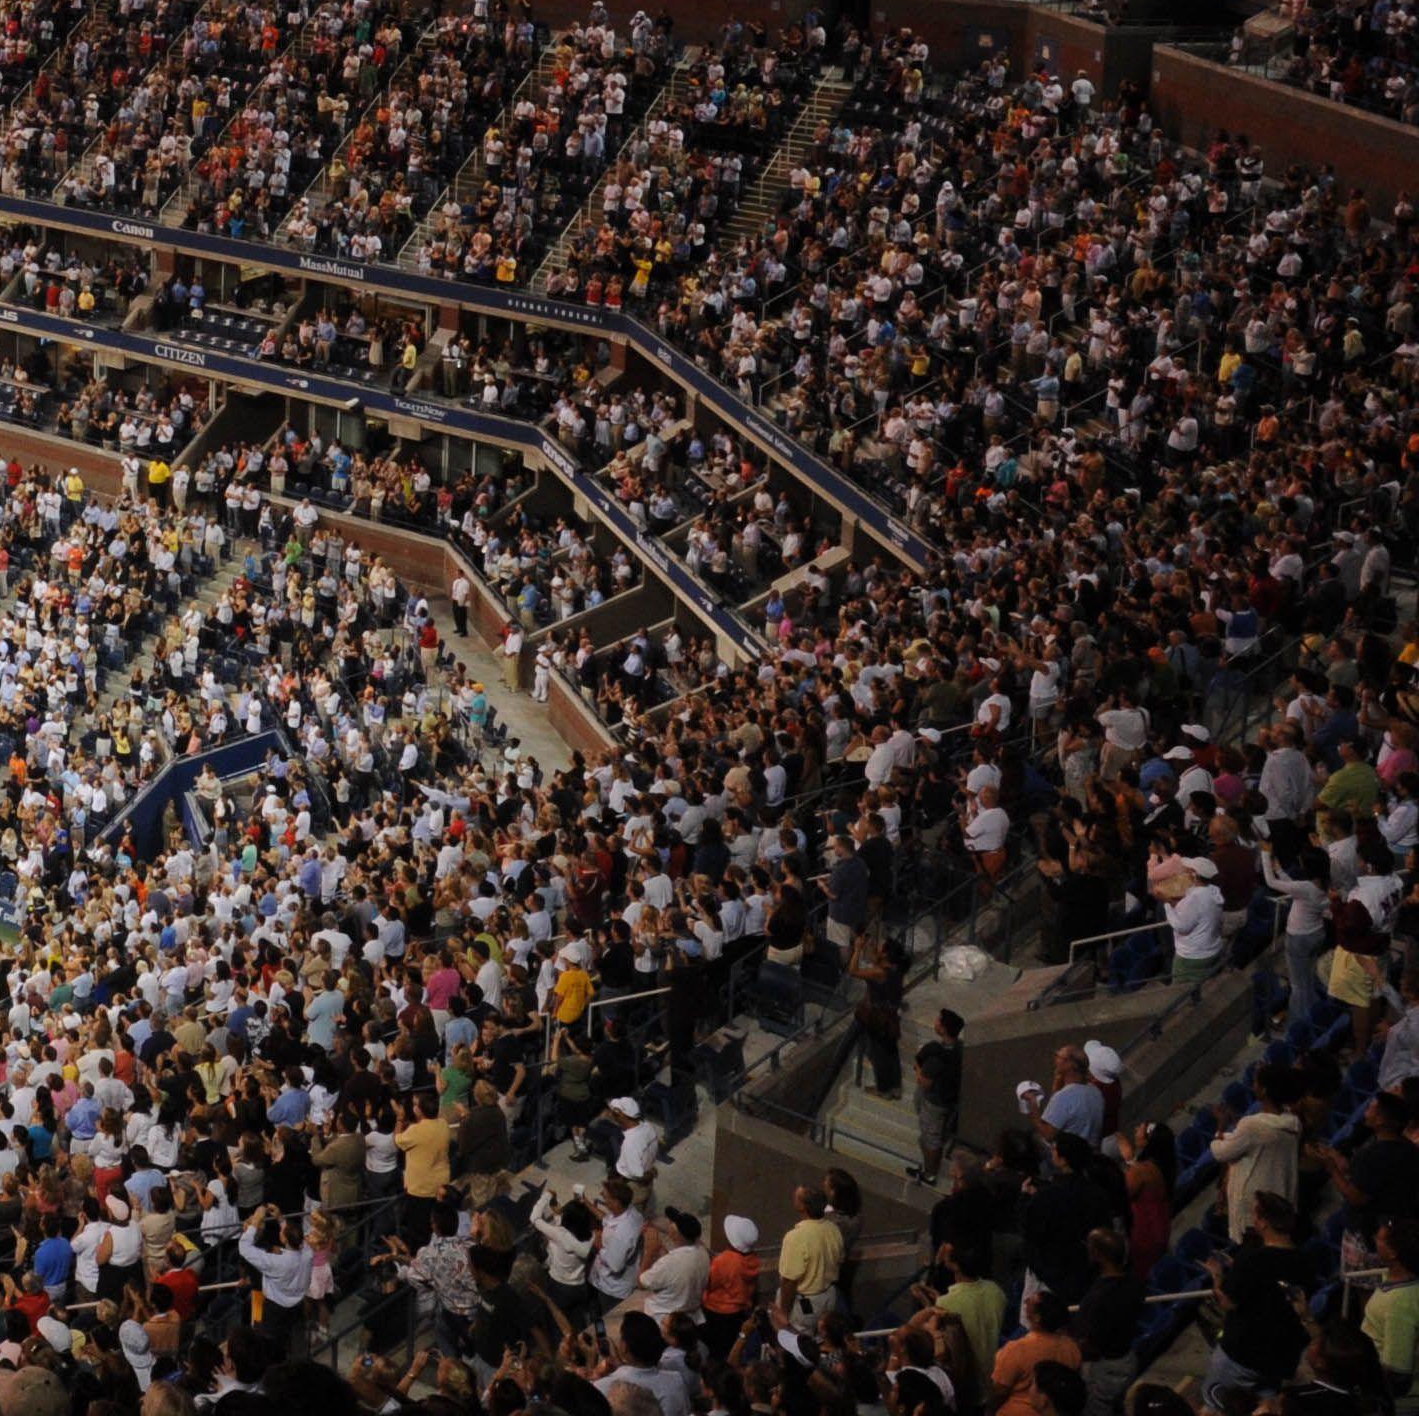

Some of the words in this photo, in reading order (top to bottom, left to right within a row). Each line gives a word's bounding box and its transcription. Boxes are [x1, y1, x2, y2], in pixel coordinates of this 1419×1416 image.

[111, 220, 154, 239] Canon
[299, 257, 365, 280] MassMutual
[154, 344, 206, 366] CITIZEN
[542, 440, 575, 480] OLYMPUS
